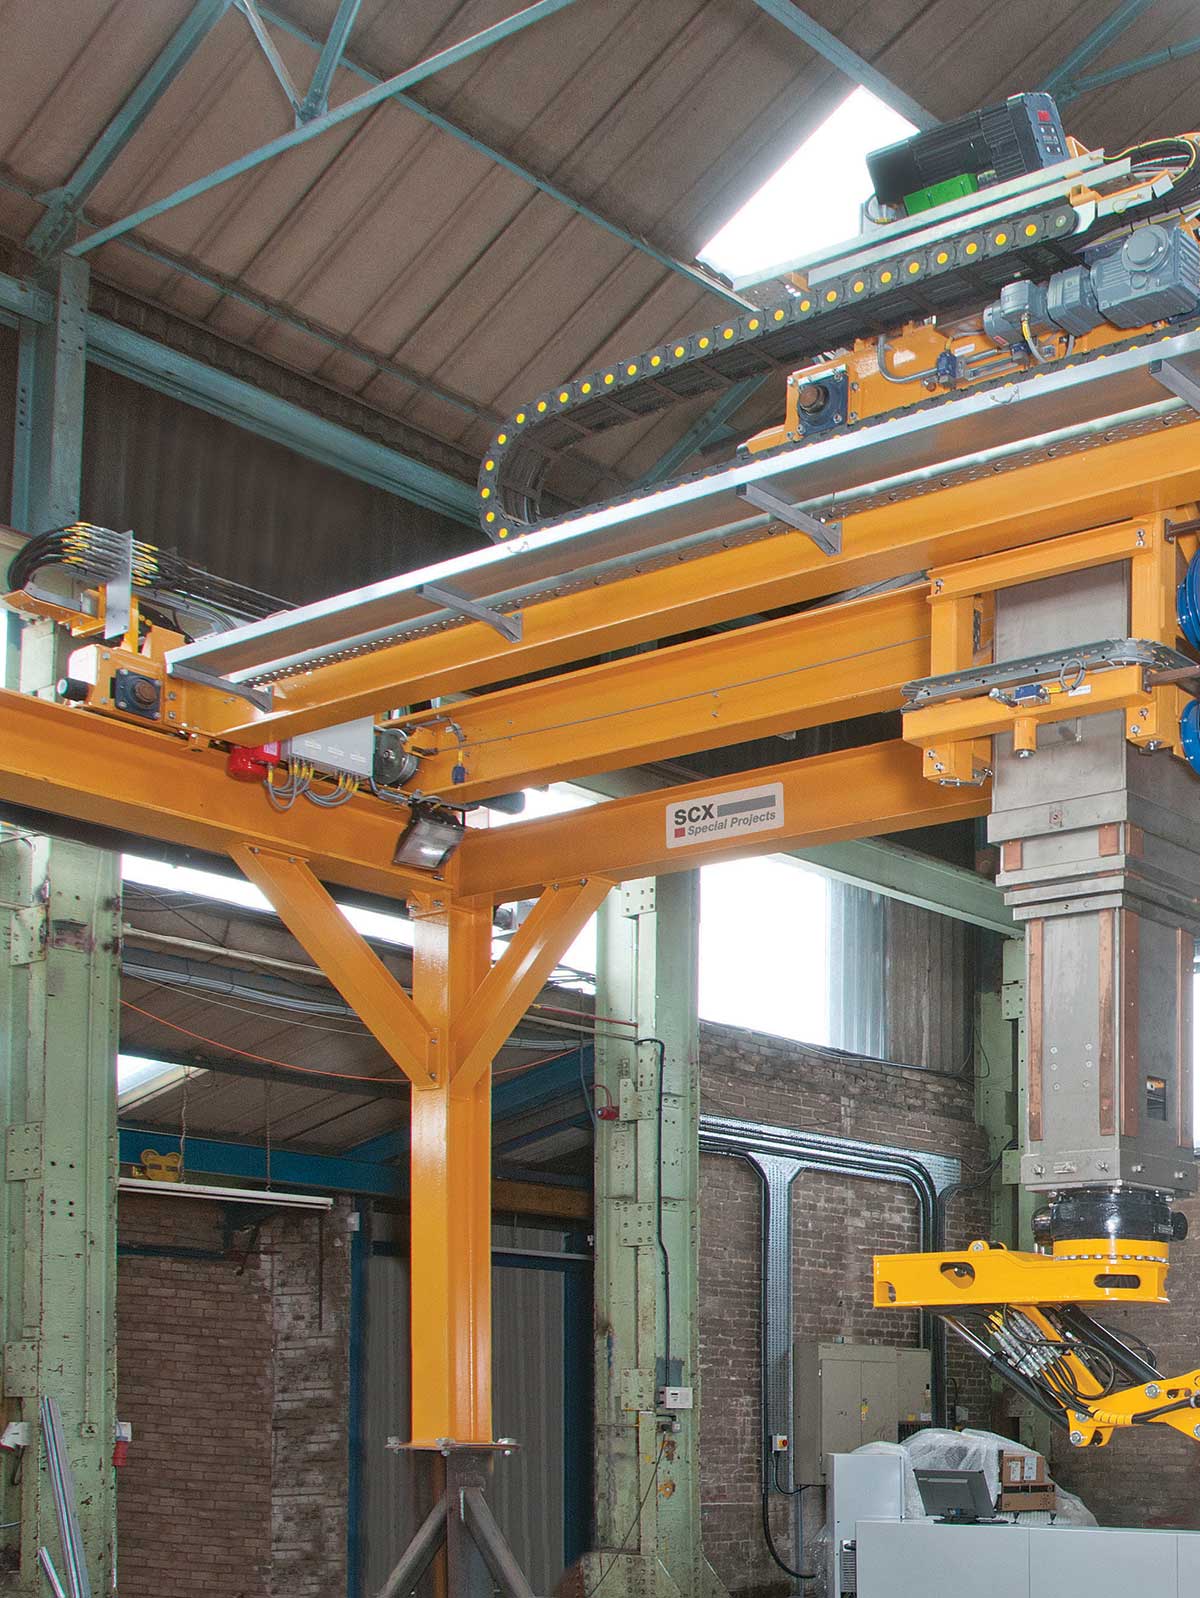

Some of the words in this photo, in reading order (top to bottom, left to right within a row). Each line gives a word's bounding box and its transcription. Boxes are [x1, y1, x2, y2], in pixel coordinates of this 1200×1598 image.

[674, 803, 715, 826] SCX
[687, 818, 728, 837] Special
[730, 811, 776, 828] Projects
